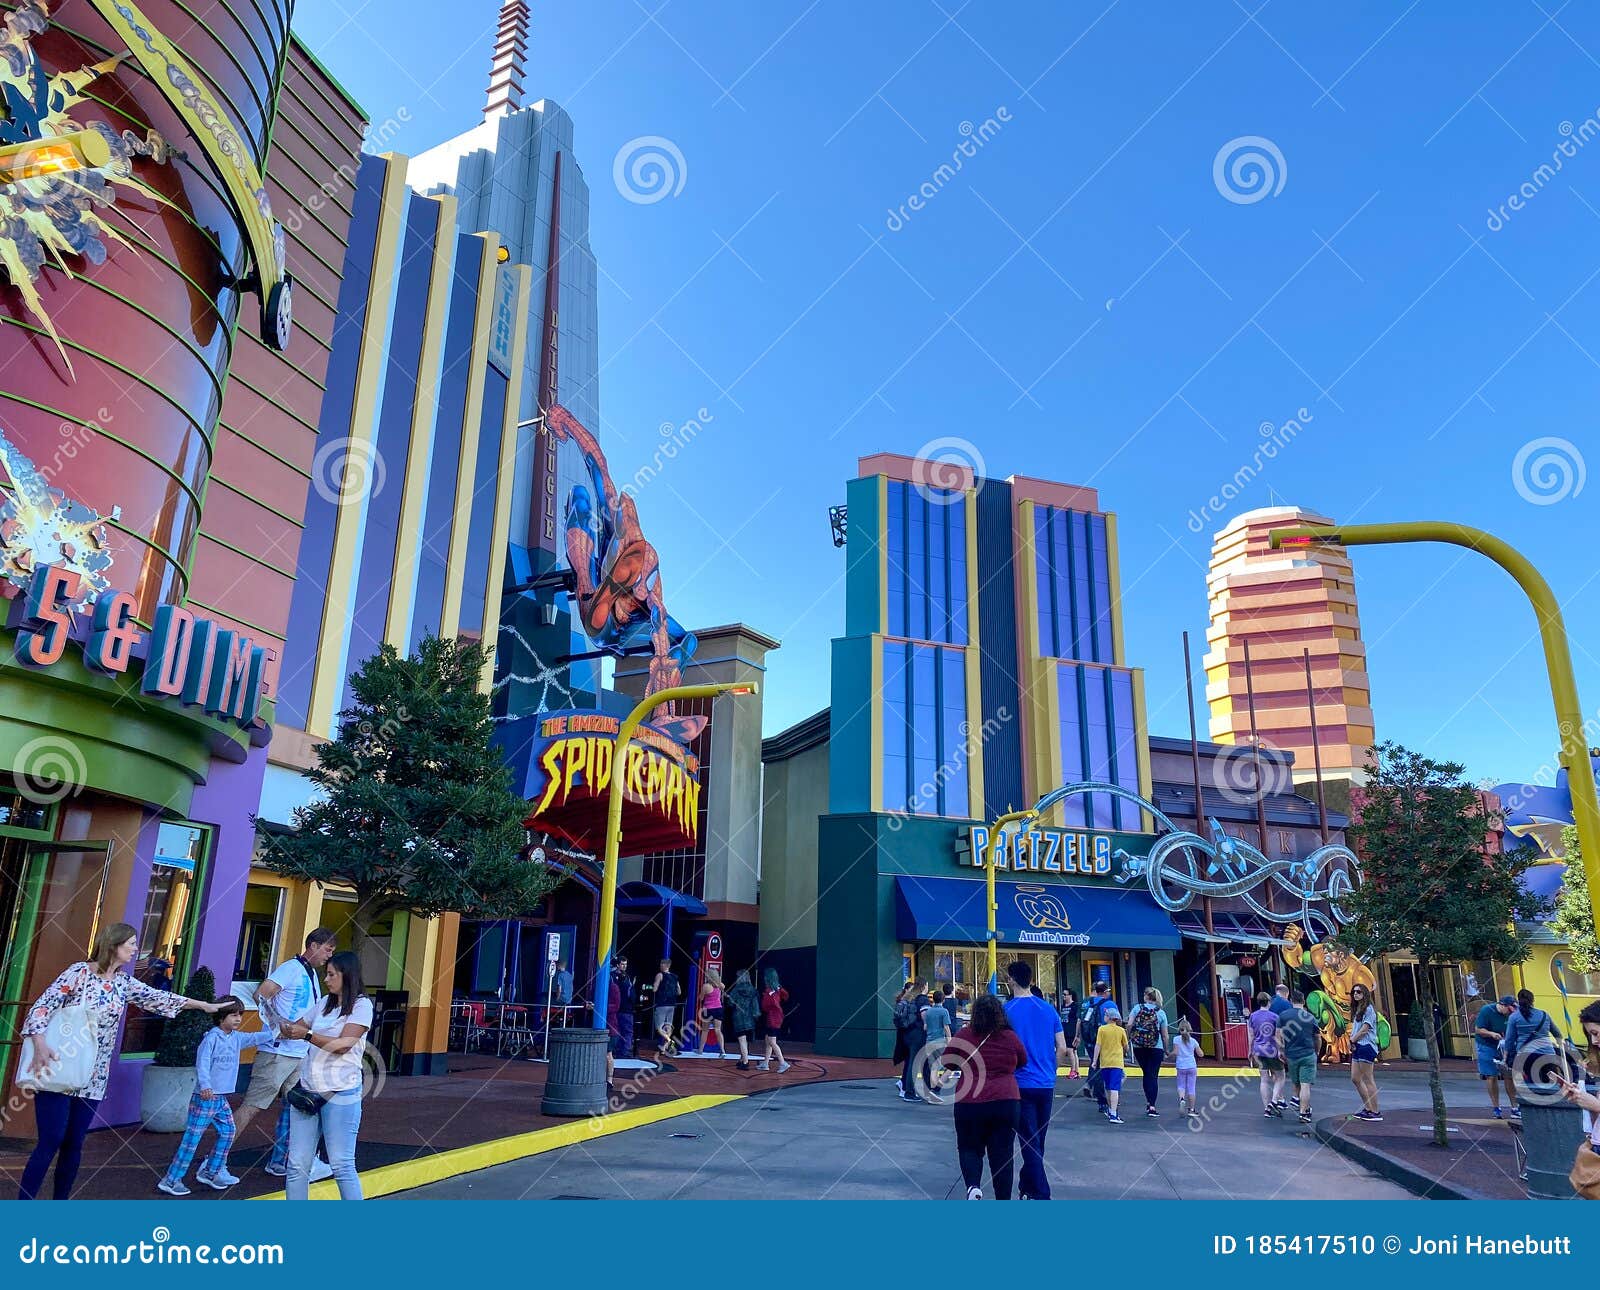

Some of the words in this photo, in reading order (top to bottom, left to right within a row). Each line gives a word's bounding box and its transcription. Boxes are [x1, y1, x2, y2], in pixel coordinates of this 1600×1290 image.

[547, 310, 559, 405] DAILY
[545, 431, 557, 540] BUGLE
[24, 564, 81, 666] 5
[93, 591, 141, 672] &
[150, 604, 277, 730] DIME
[542, 716, 568, 737] THE
[569, 714, 620, 734] AMAZING
[534, 736, 701, 839] SPIDR-MAN
[970, 826, 1113, 874] PRETZELS
